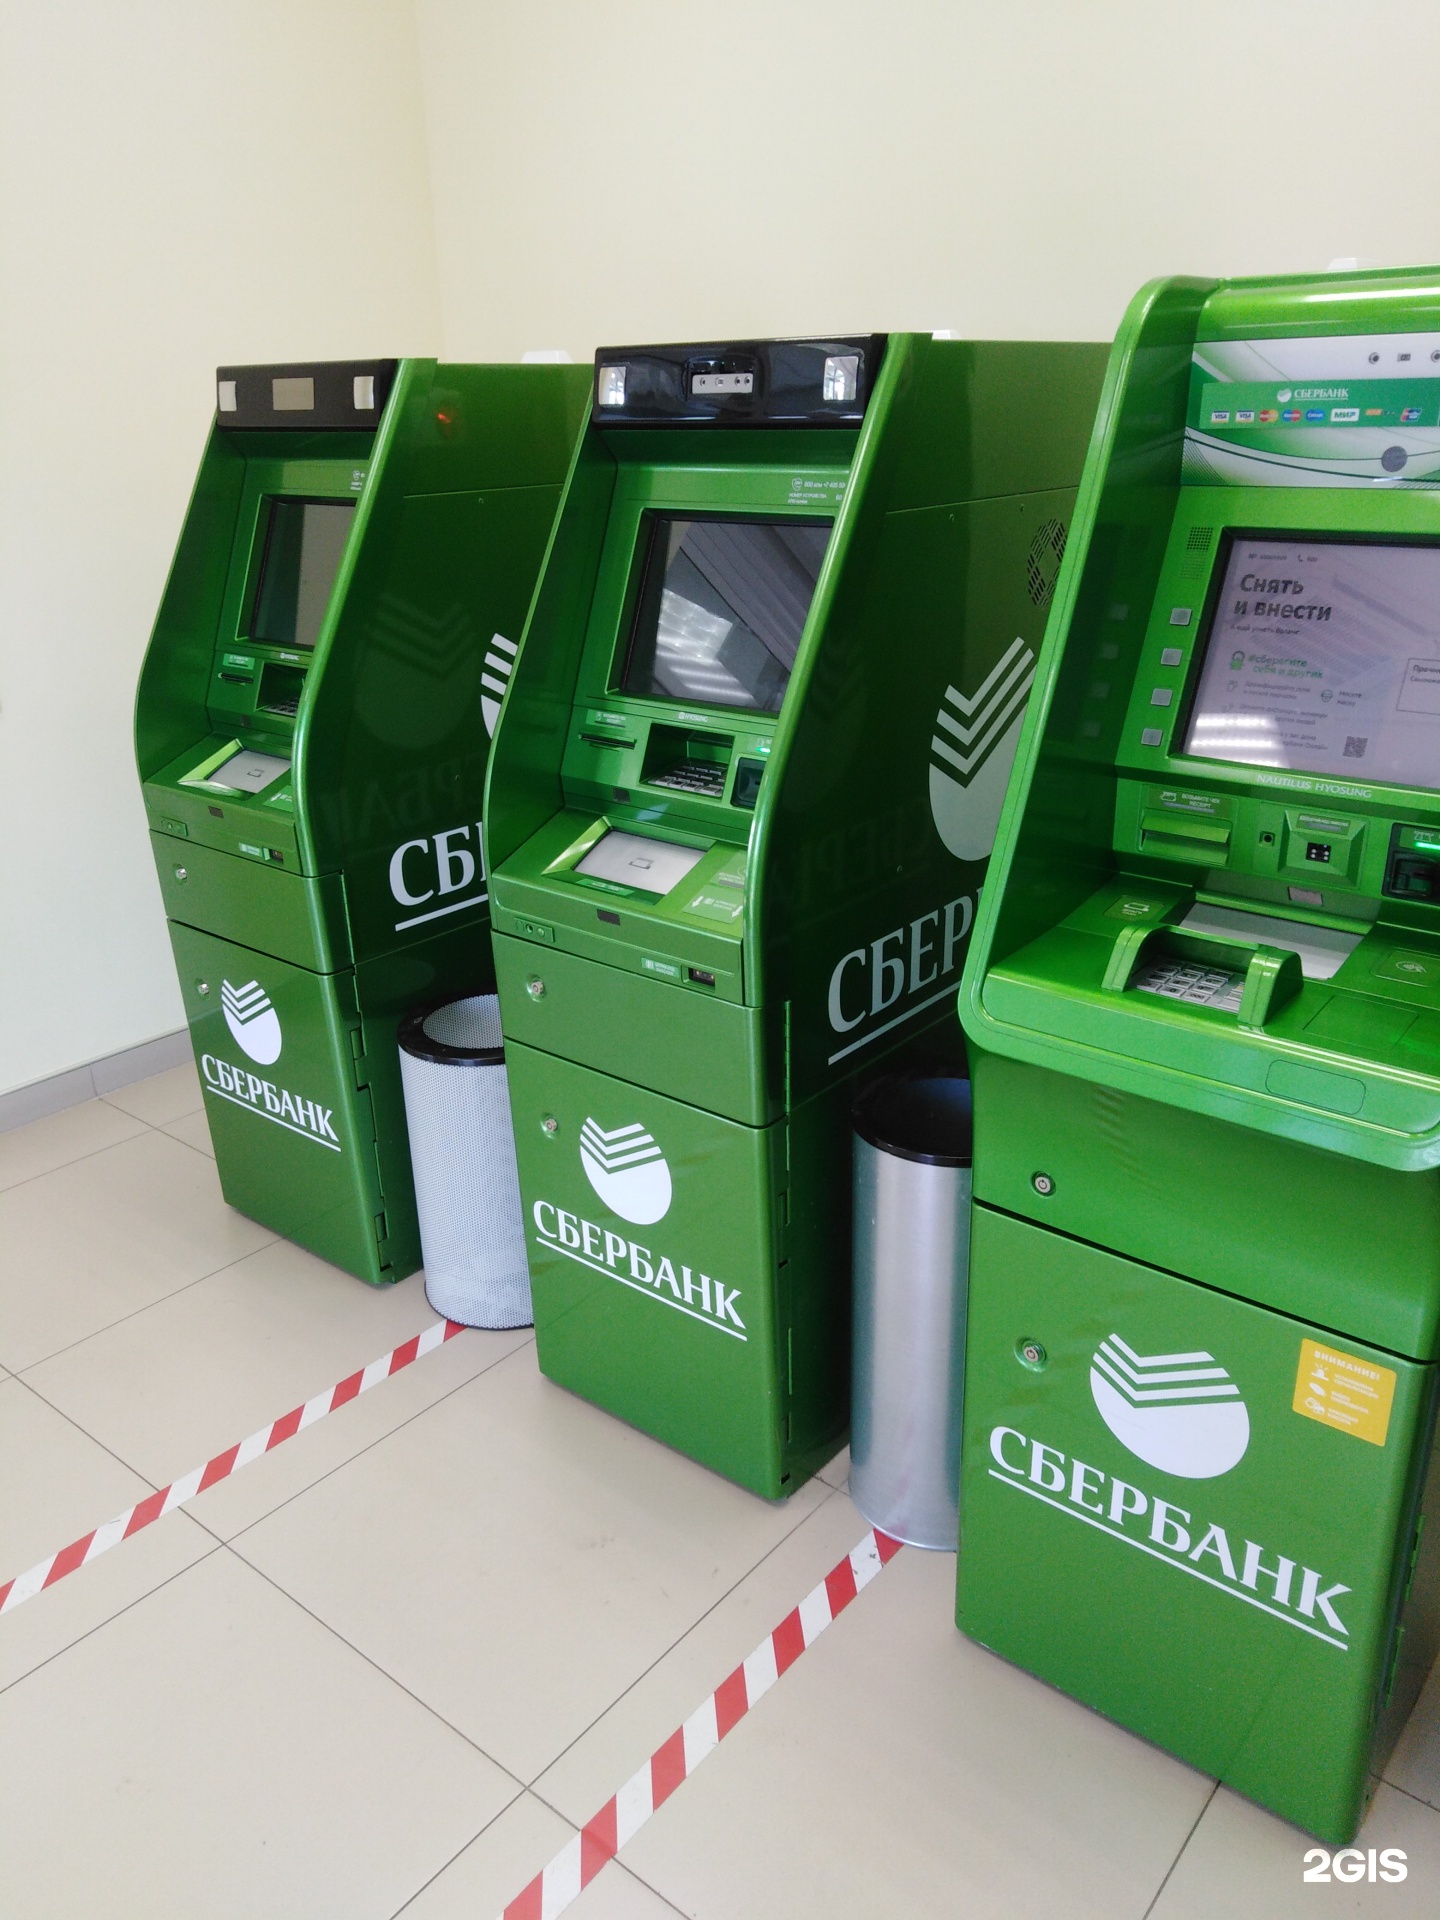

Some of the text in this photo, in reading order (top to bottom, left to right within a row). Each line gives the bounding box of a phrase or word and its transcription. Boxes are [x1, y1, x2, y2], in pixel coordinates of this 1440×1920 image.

[1294, 388, 1349, 398] СБЕРБАНК
[1240, 574, 1304, 595] Снять
[1234, 601, 1332, 621] и внести
[1257, 774, 1372, 798] NAUTILUS HYOSUNG
[828, 887, 983, 1033] СБЕР
[201, 1054, 339, 1143] СБЕРБАНК
[533, 1200, 746, 1330] СБЕРБАНК
[1314, 1350, 1380, 1381] ВНИМАНИЕ!
[989, 1426, 1352, 1636] СБЕРБАНК
